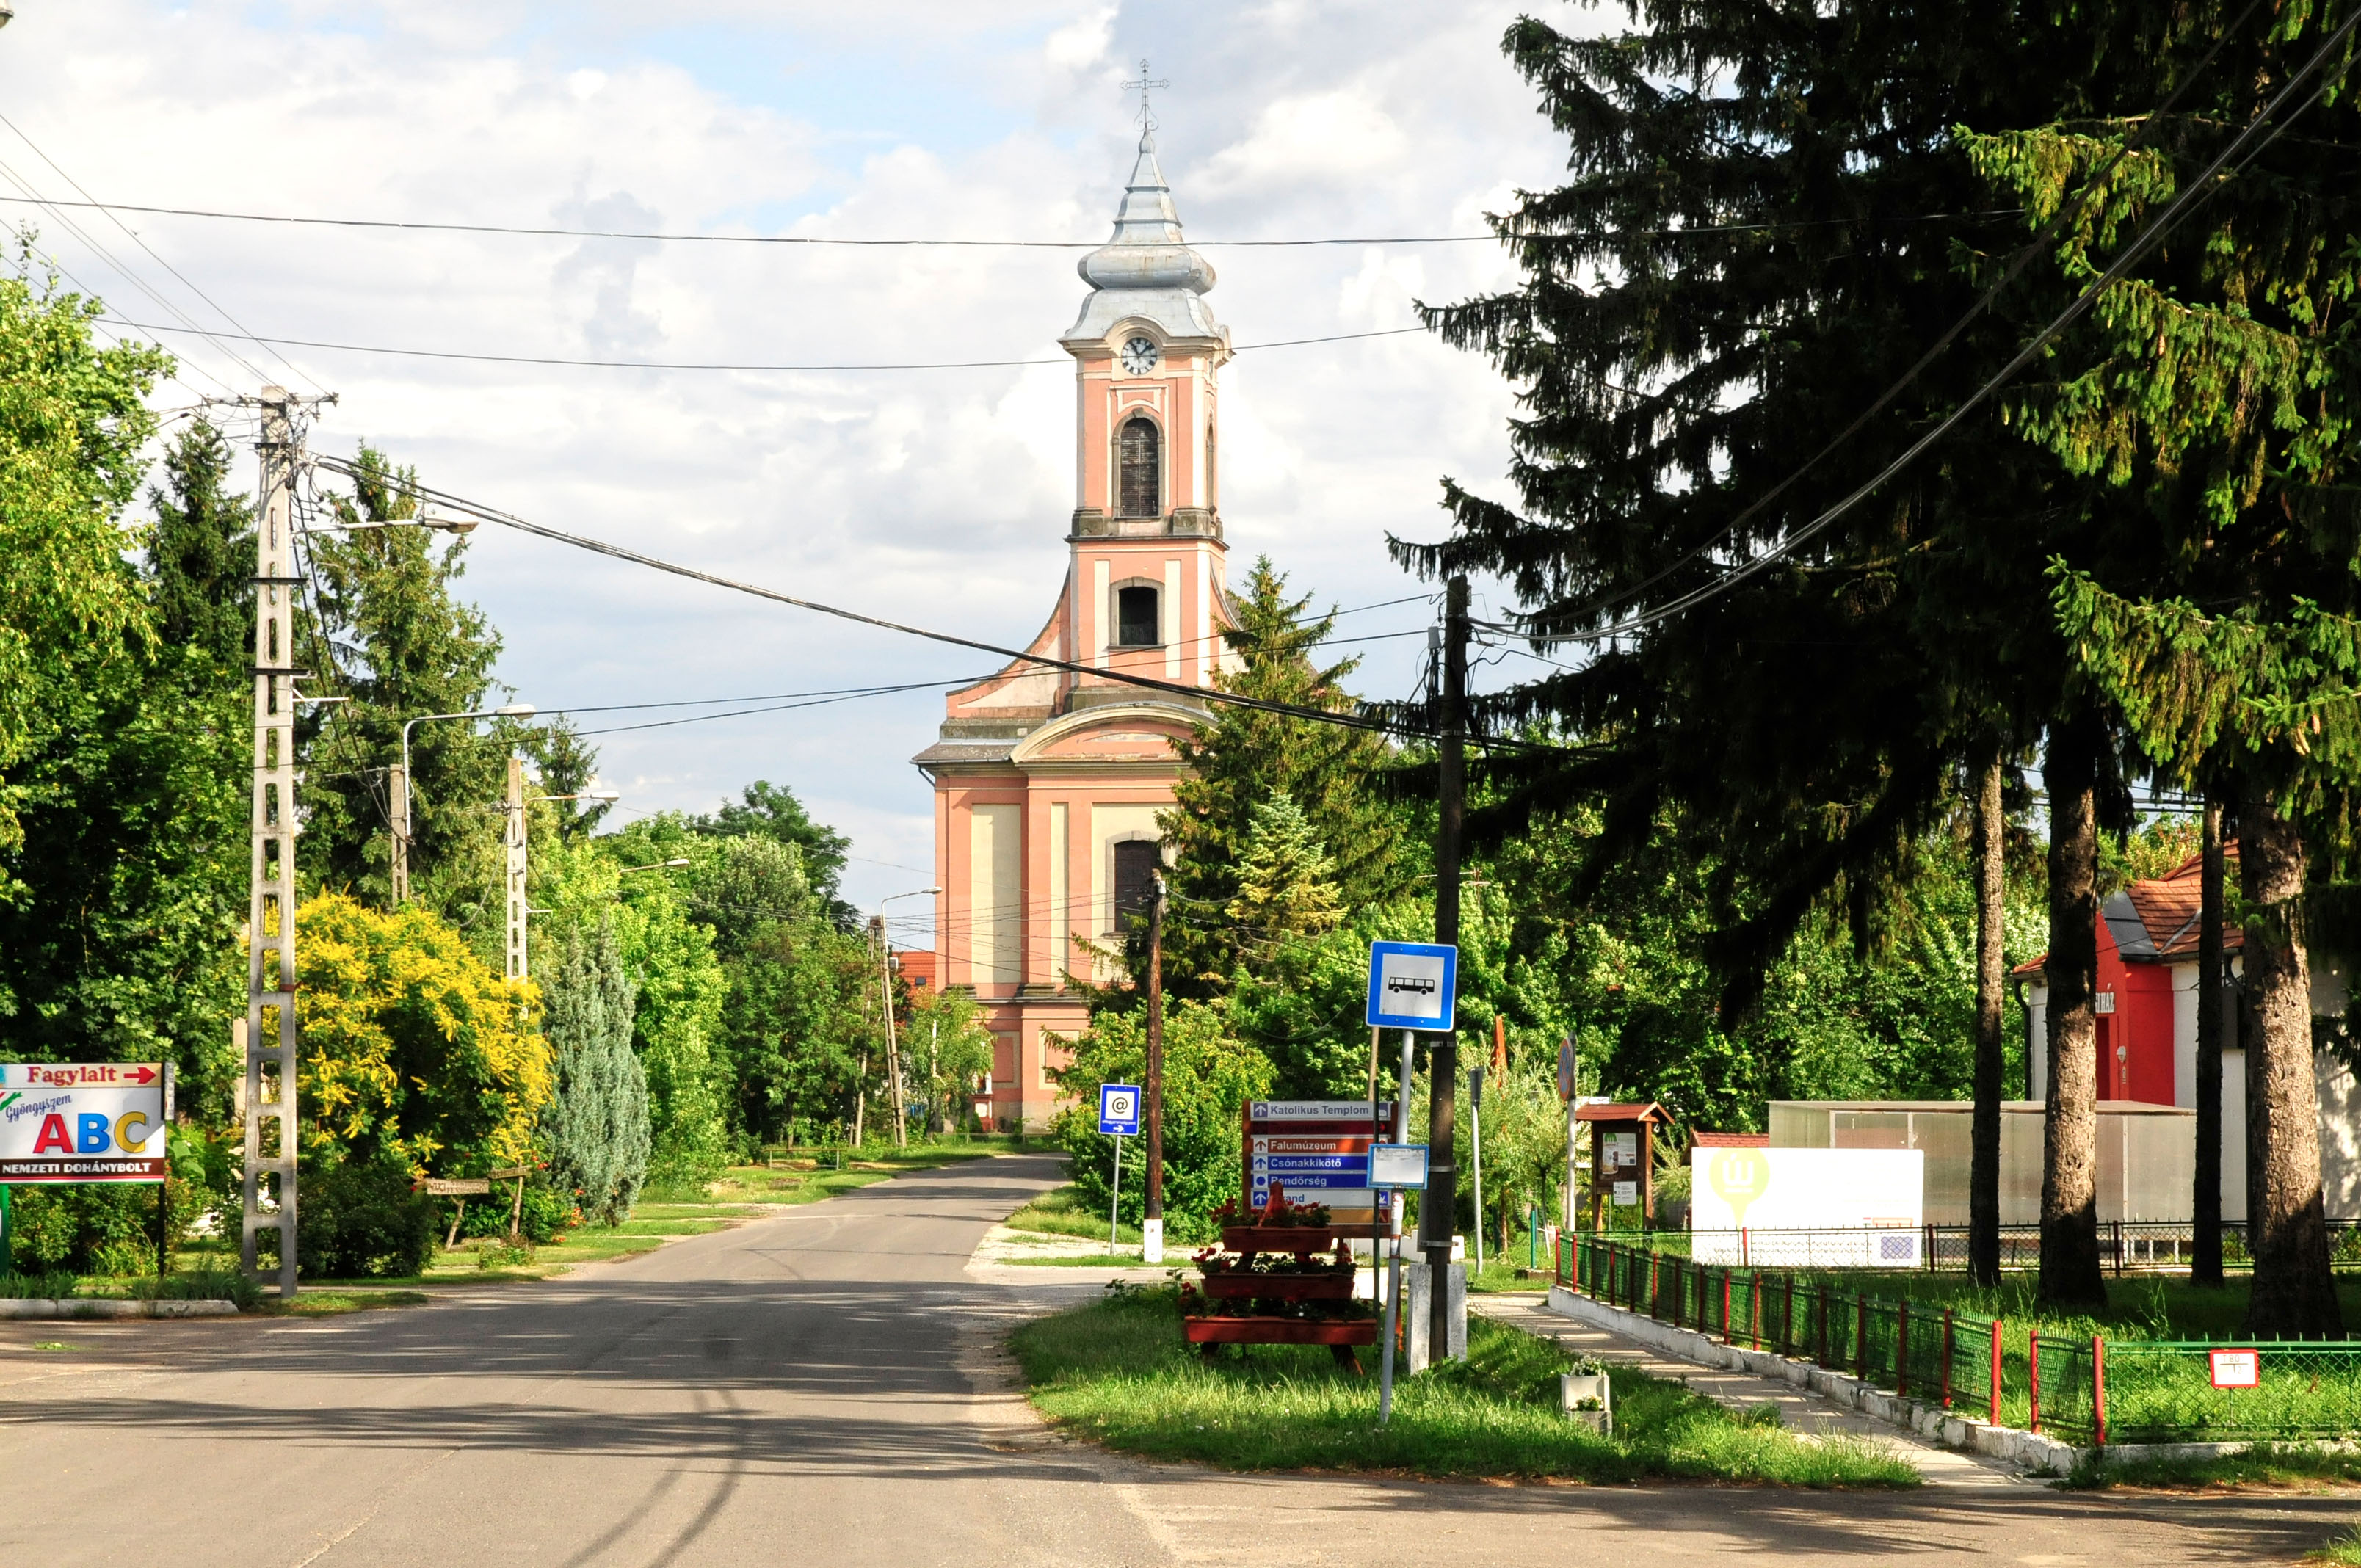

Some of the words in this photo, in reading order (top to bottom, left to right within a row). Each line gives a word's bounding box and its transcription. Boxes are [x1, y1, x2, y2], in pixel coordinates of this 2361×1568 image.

[2100, 983, 2115, 1014] HÁZ
[27, 1066, 117, 1086] Fagylalt
[5, 1095, 72, 1123] Gyöngyszem
[1271, 1106, 1319, 1115] Katolikus
[1321, 1106, 1369, 1117] Templom
[32, 1111, 147, 1154] ABC
[1271, 1141, 1336, 1150] Falumúzeum
[2, 1164, 59, 1174] NEMZETI
[63, 1161, 152, 1173] DOHÁNYBOLT
[1271, 1158, 1341, 1168] Csónakkikötő
